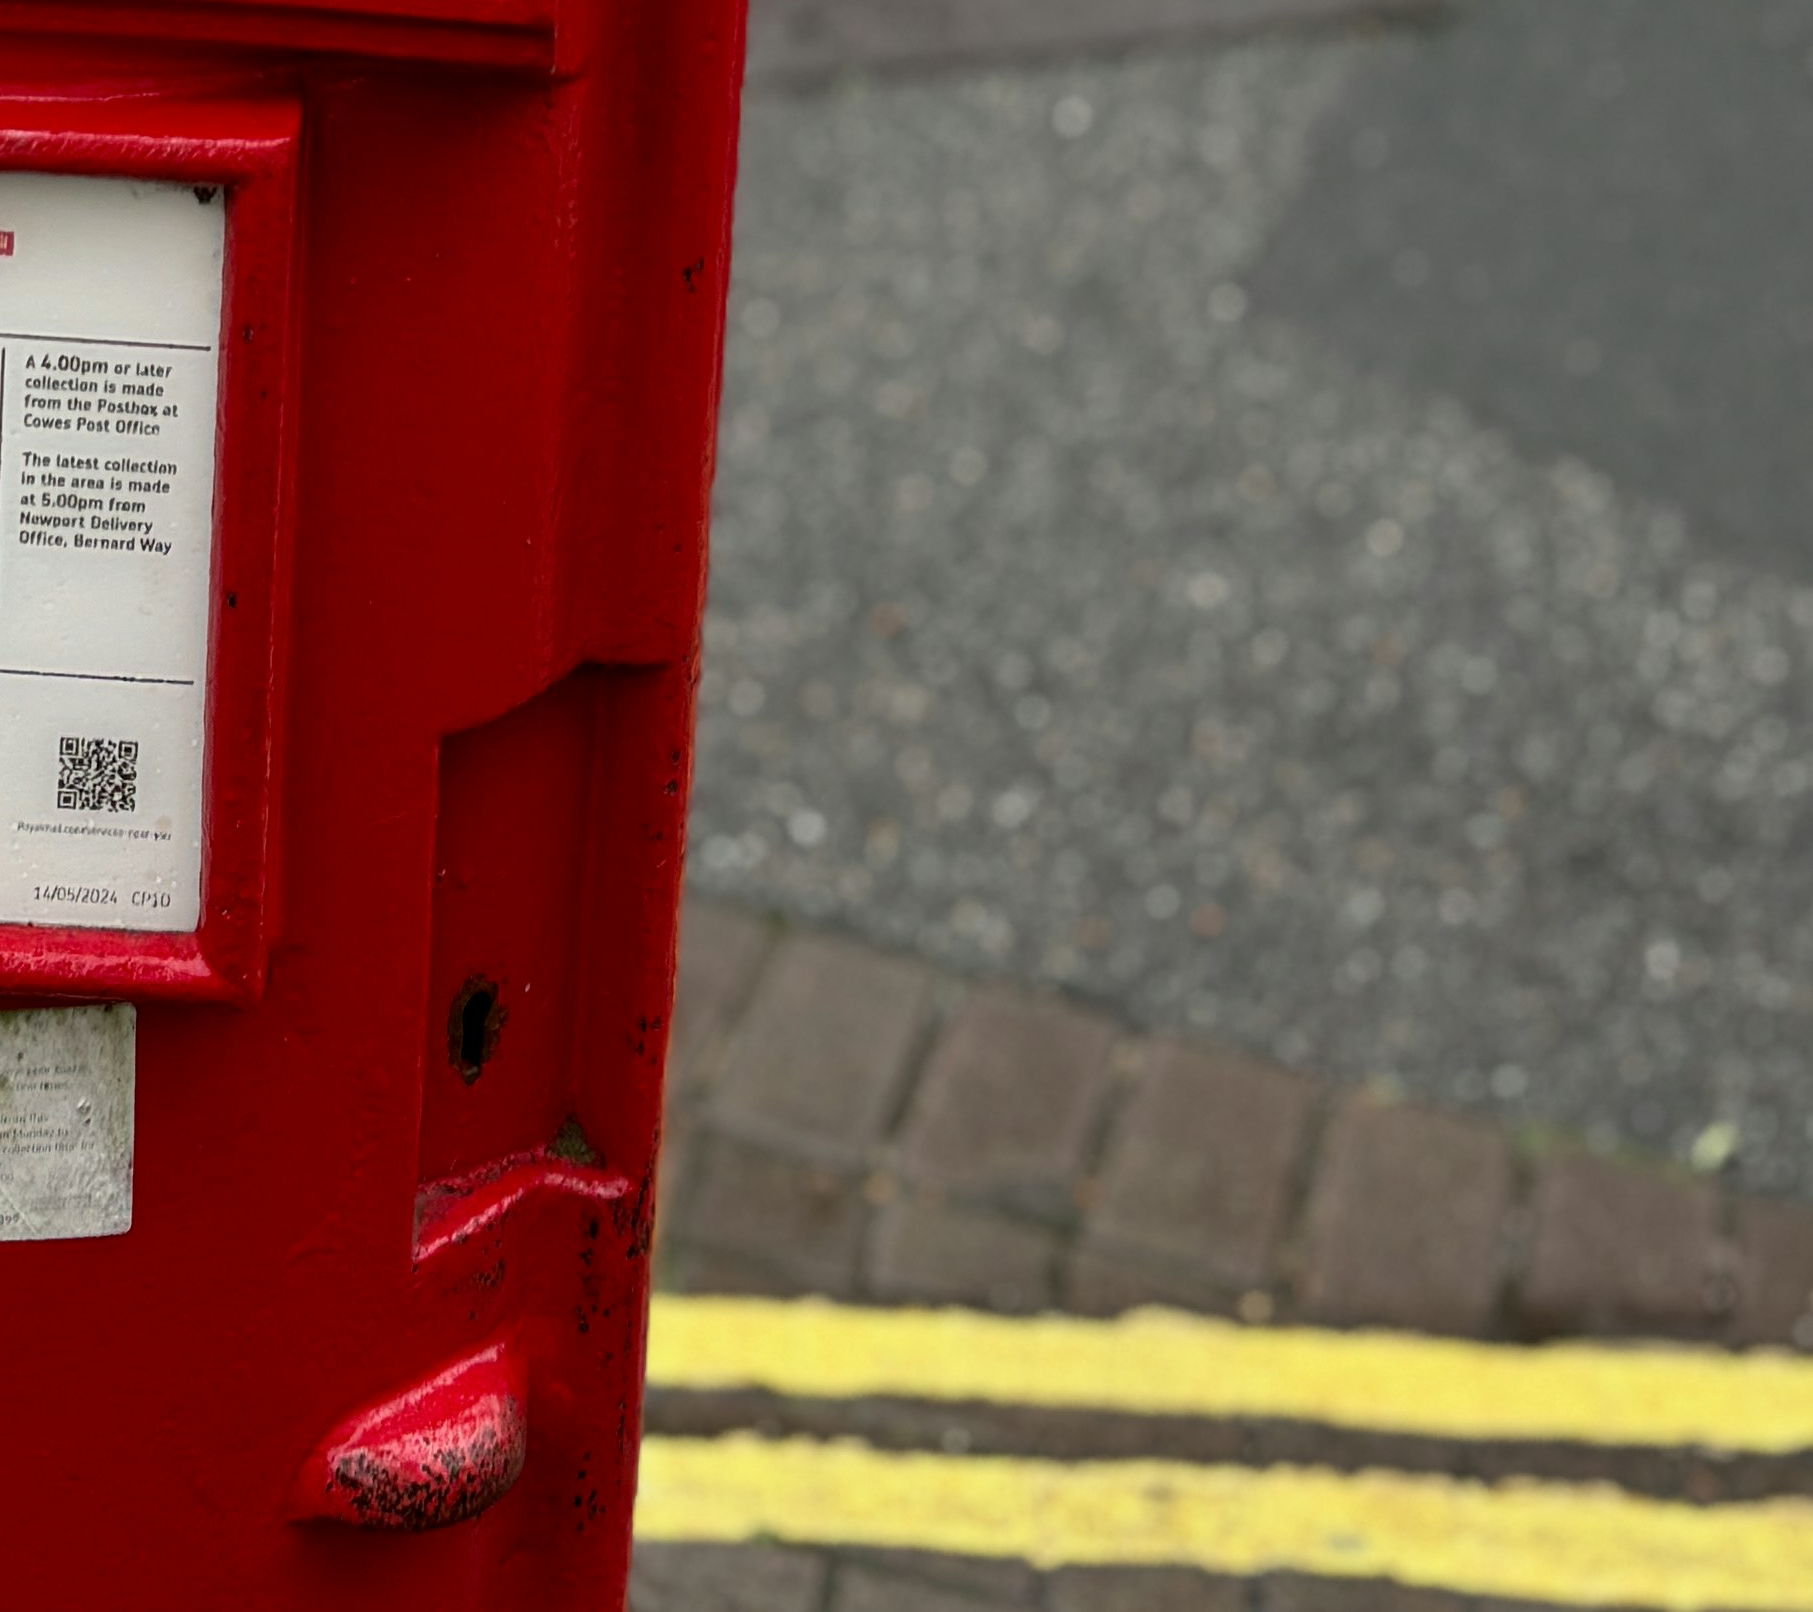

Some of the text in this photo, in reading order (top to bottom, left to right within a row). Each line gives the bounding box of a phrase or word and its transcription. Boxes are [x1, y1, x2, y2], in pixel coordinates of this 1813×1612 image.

[25, 353, 173, 378] A 4.00pm or later
[25, 375, 164, 397] collection is made
[24, 394, 62, 411] from
[67, 397, 92, 411] the
[162, 404, 179, 418] at
[23, 413, 161, 436] Cowes Post Office
[22, 451, 178, 476] The latest collection
[21, 471, 171, 494] in the area is made
[20, 492, 146, 513] at 5.00pm from
[19, 511, 154, 535] Newport Delivery
[19, 530, 173, 556] Office, Bernard Way
